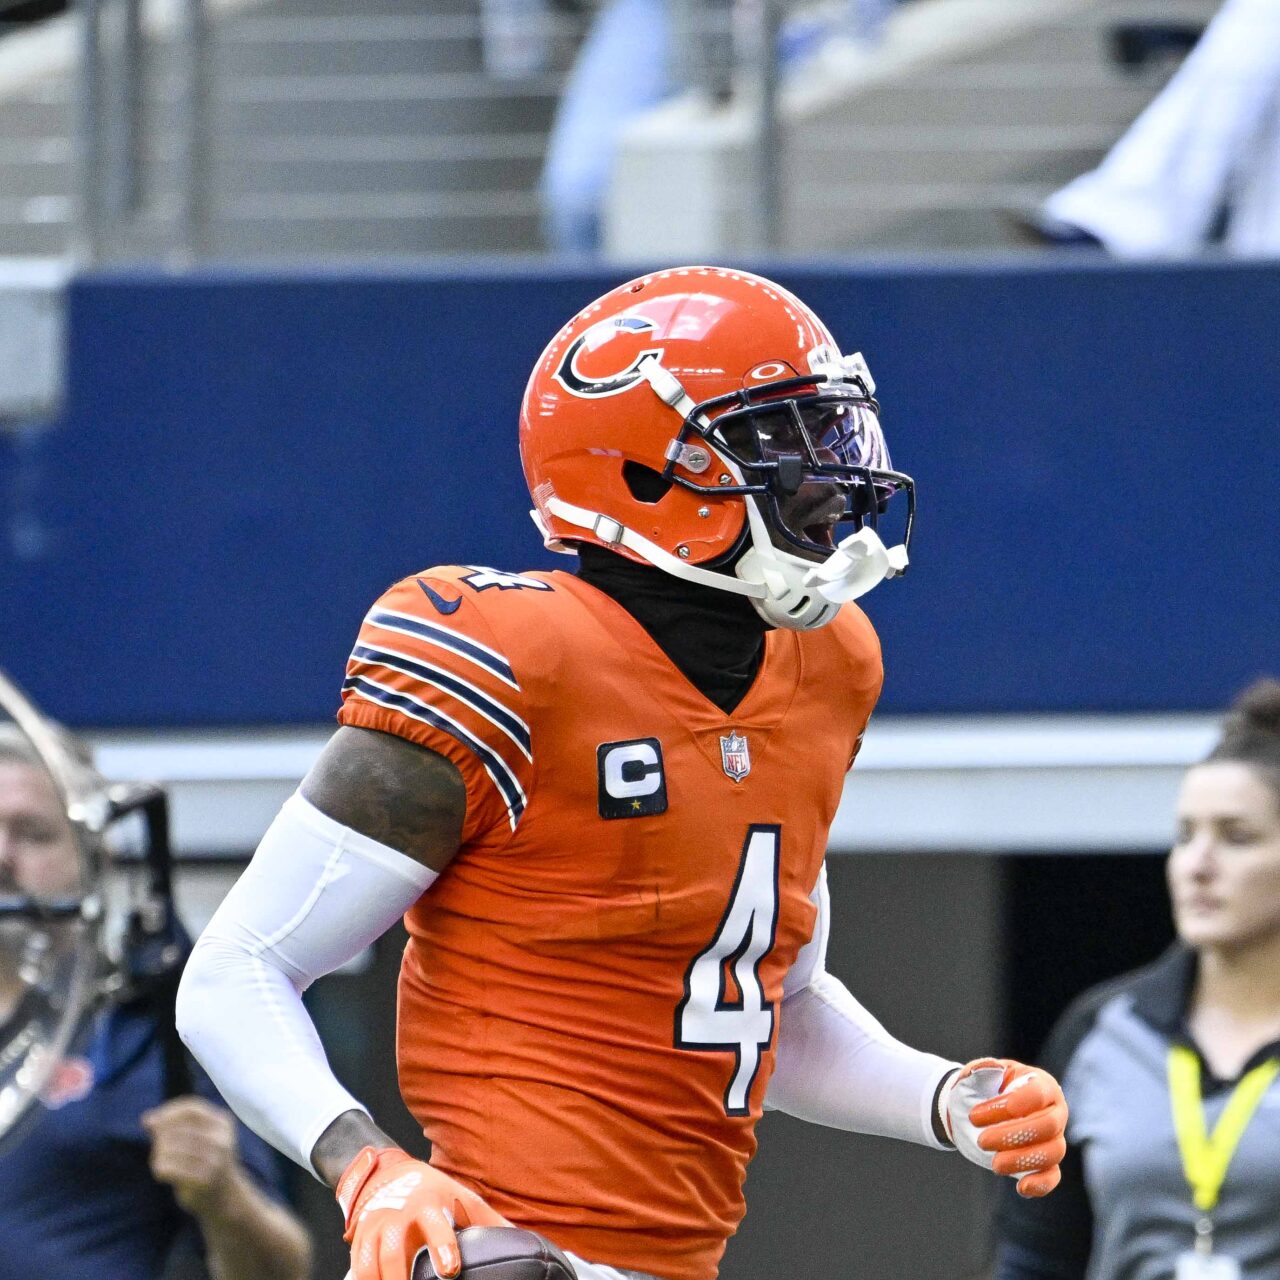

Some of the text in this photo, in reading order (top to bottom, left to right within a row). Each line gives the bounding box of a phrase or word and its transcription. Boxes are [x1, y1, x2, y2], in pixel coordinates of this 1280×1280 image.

[604, 743, 660, 798] C
[727, 753, 746, 773] NFL
[674, 823, 782, 1117] 4
